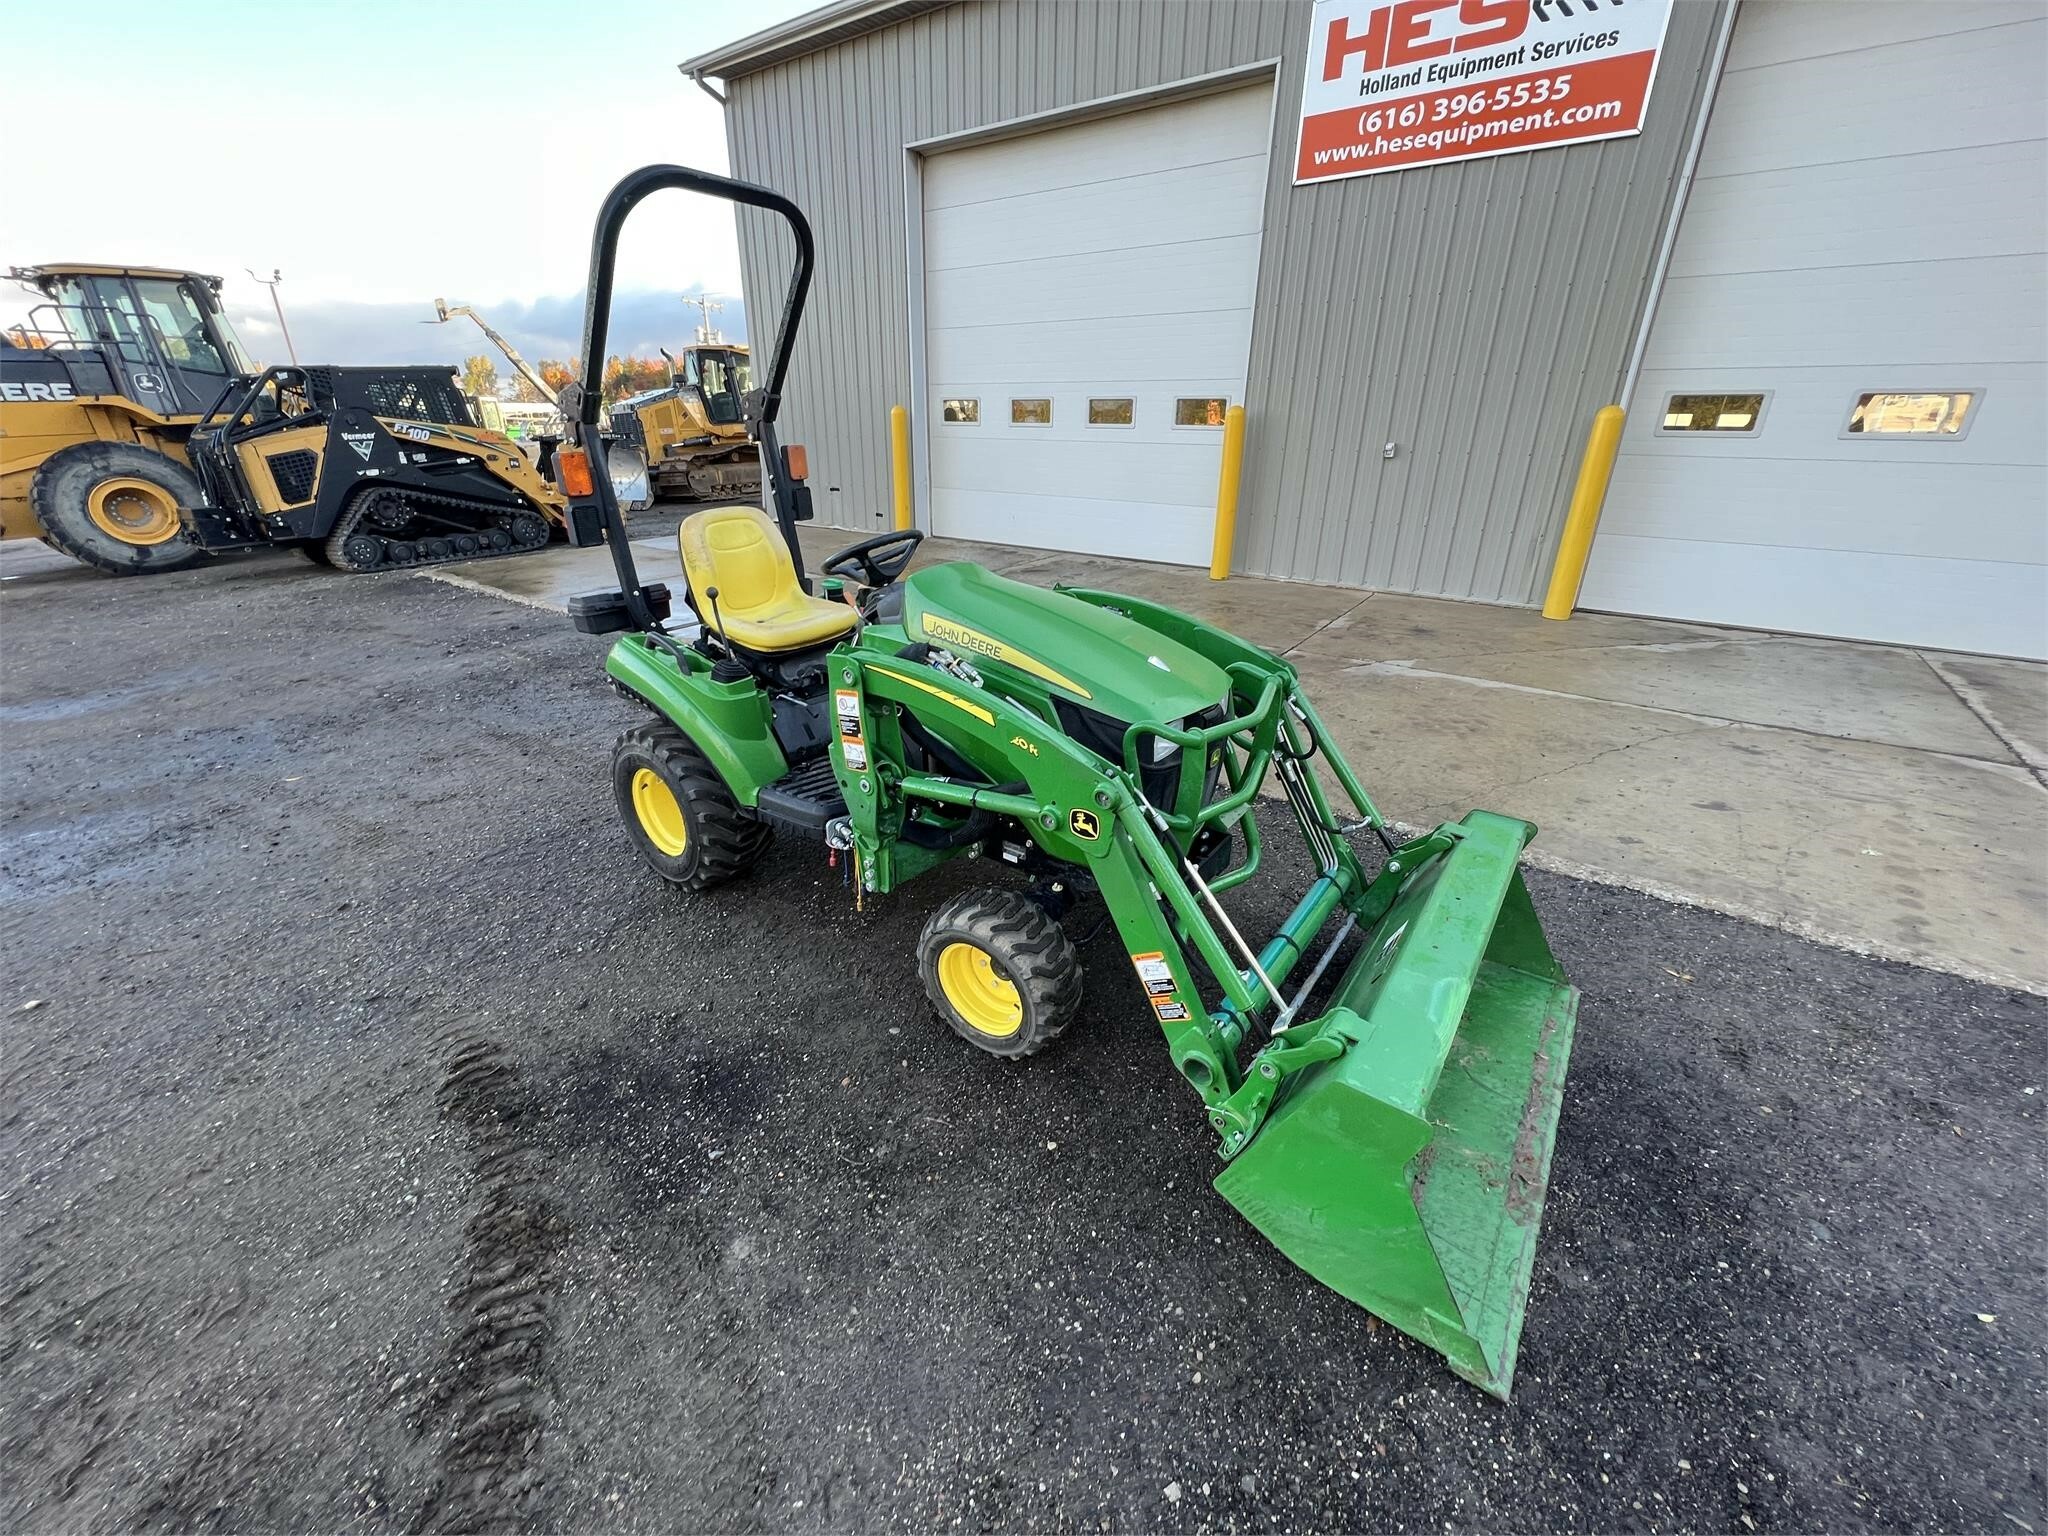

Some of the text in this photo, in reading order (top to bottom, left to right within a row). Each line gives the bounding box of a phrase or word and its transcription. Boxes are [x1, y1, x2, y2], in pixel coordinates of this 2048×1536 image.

[1323, 0, 1530, 82] HES
[1359, 29, 1620, 97] Holland Equipment Services
[1314, 98, 1622, 164] www.hesequipment.com
[1358, 101, 1426, 136] (616)
[0, 382, 76, 402] ERE
[341, 431, 376, 441] Vermeer
[929, 621, 1002, 658] JOHN DEERE
